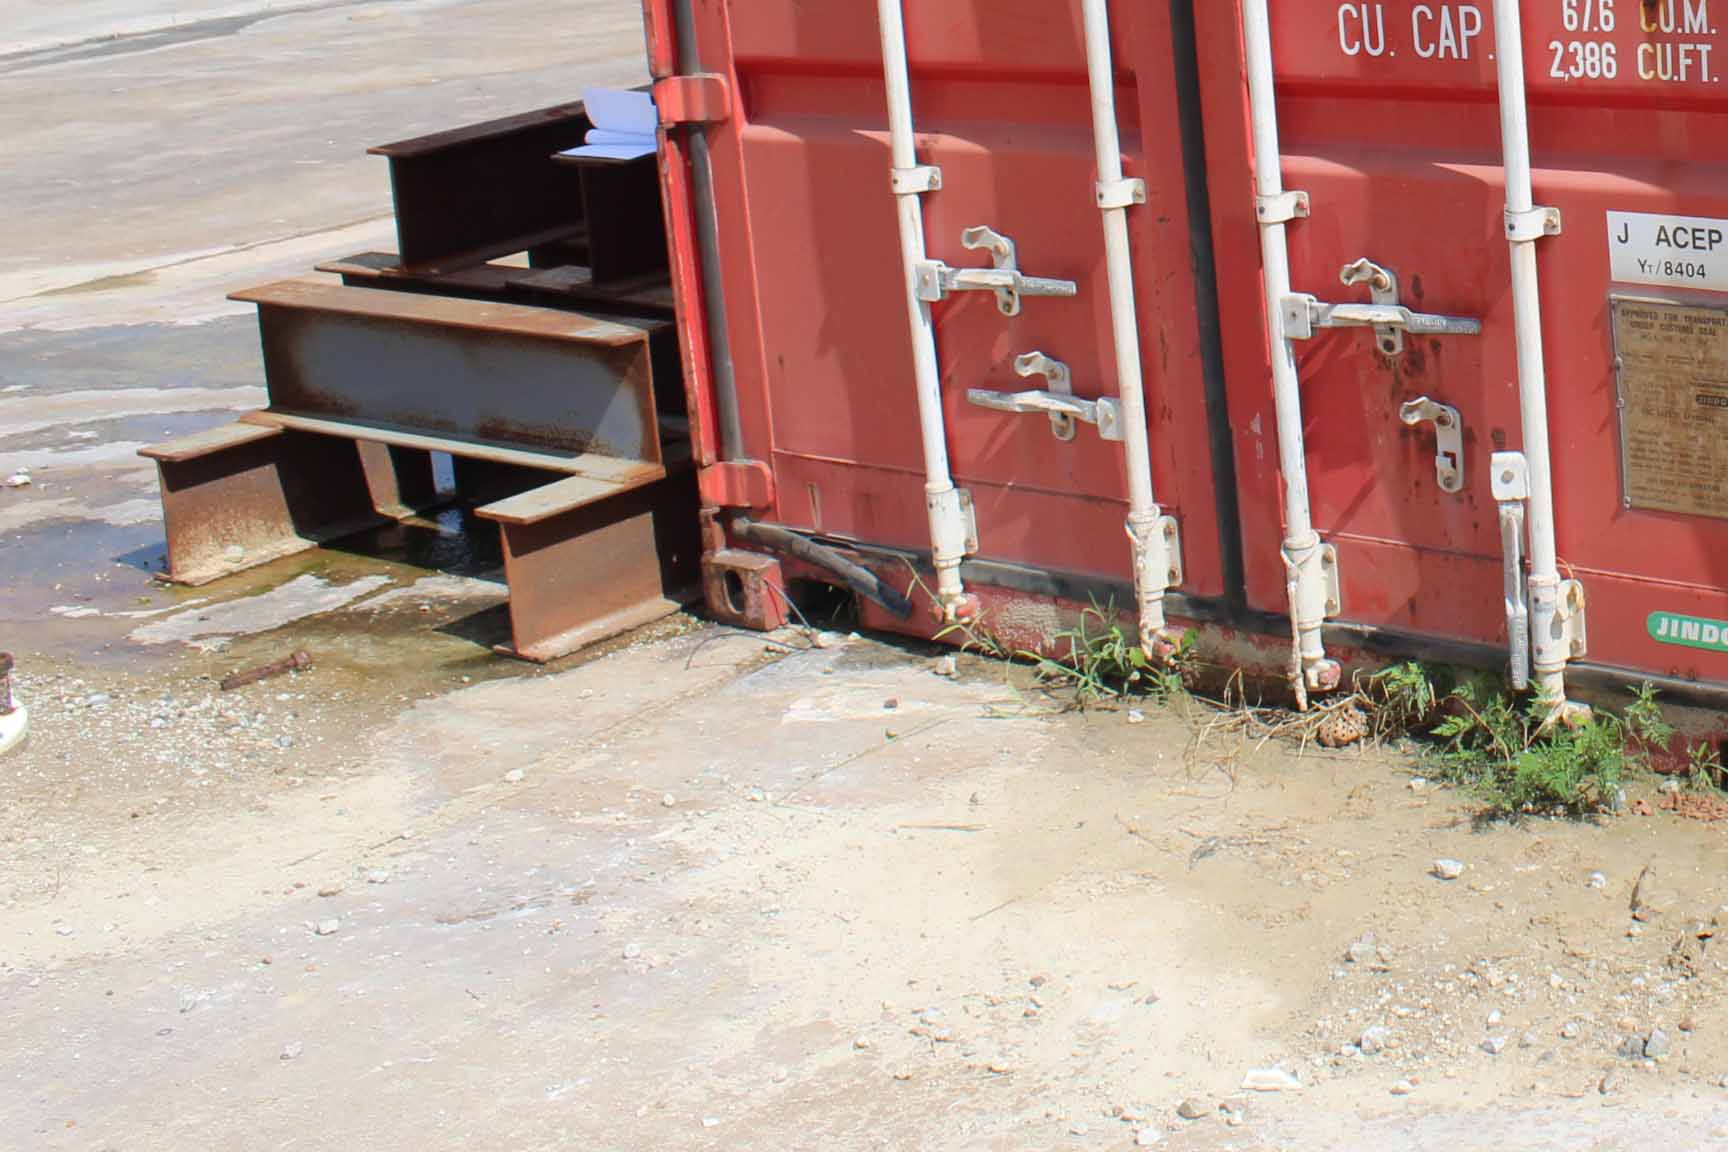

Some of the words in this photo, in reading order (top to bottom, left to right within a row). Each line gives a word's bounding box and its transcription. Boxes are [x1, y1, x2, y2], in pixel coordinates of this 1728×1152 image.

[1337, 3, 1395, 57] CU.
[1548, 41, 1617, 82] 2,386
[1637, 42, 1720, 83] CU.FT.
[1617, 223, 1629, 244] J
[1655, 225, 1722, 251] ACEP
